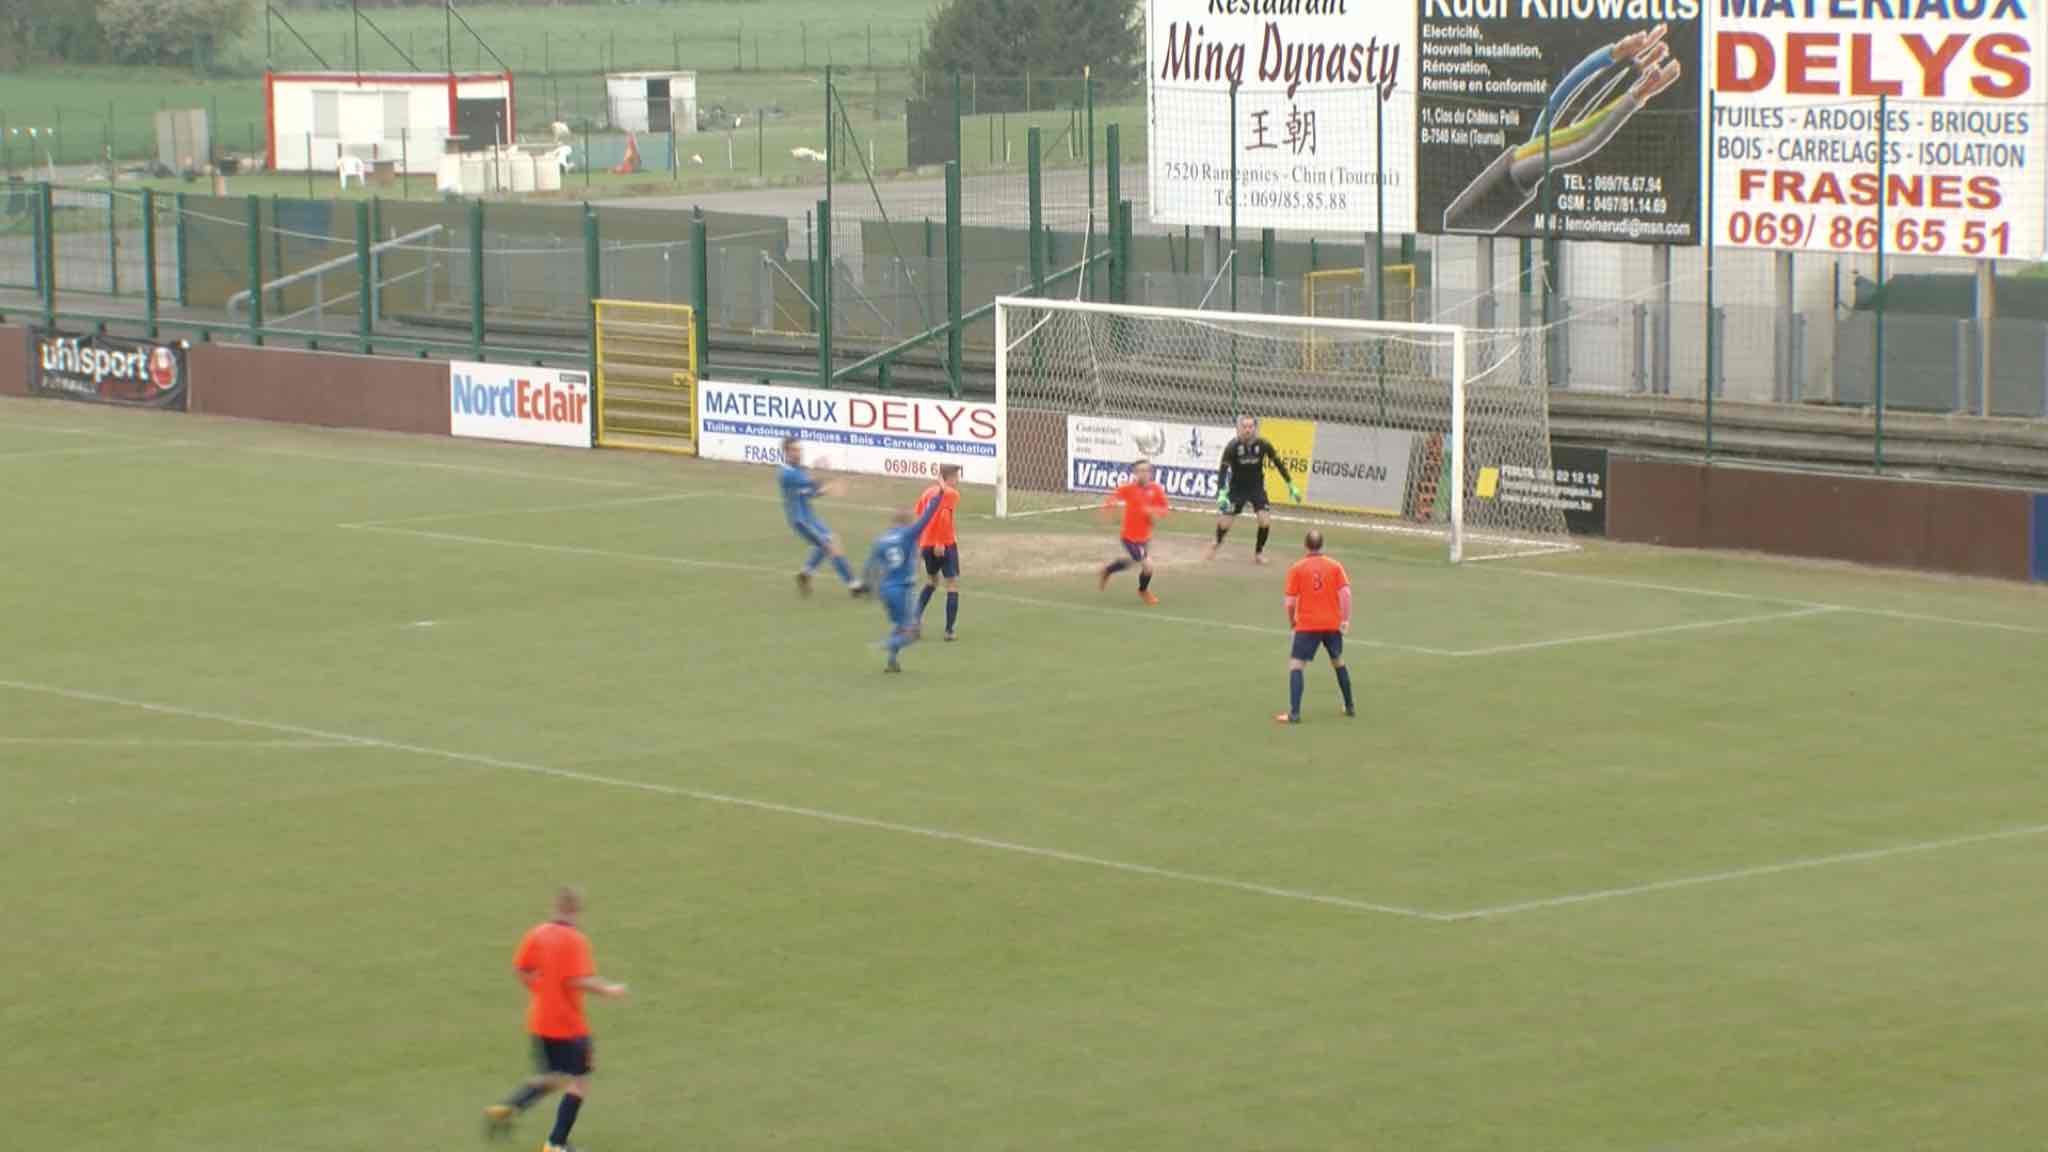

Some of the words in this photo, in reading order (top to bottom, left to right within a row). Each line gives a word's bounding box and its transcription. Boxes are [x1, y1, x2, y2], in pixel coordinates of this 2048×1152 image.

[1161, 21, 1245, 95] Ming
[1259, 21, 1400, 101] Dynasty
[1423, 42, 1473, 57] Nouvelle
[1716, 31, 2031, 99] DELYS
[1423, 59, 1490, 77] Rénovation,
[1423, 76, 1466, 91] Remise
[1468, 80, 1483, 91] en
[1485, 78, 1547, 94] conformité
[1245, 104, 1317, 155] 王朝
[1714, 106, 1783, 128] TUILES
[1803, 107, 1909, 131] ARDOISES
[1931, 111, 2029, 137] BRIQUES
[1718, 136, 1761, 160] BOIS
[1778, 138, 1901, 164] CARRELAGES
[1919, 142, 2025, 167] ISOLATION
[1165, 161, 1199, 180] 7520
[1292, 165, 1327, 185] Chin
[1564, 173, 1585, 190] TEL
[1739, 169, 2003, 210] FRASNES
[1557, 193, 1584, 210] GSM
[1728, 211, 1816, 248] 069/
[1829, 215, 1879, 250] 86
[1896, 218, 1946, 252] 65
[1962, 221, 2010, 255] 51
[41, 337, 149, 384] uhlsport
[453, 375, 587, 424] NordEclair
[705, 391, 837, 423] MATERIAUX
[849, 398, 997, 439] DELYS
[706, 421, 736, 433] Tuiles
[946, 442, 994, 457] Isolation
[745, 445, 785, 463] FRASN
[1078, 462, 1137, 488] Vince
[1155, 468, 1218, 497] LUCAS
[1312, 459, 1387, 481] GROSJEAN
